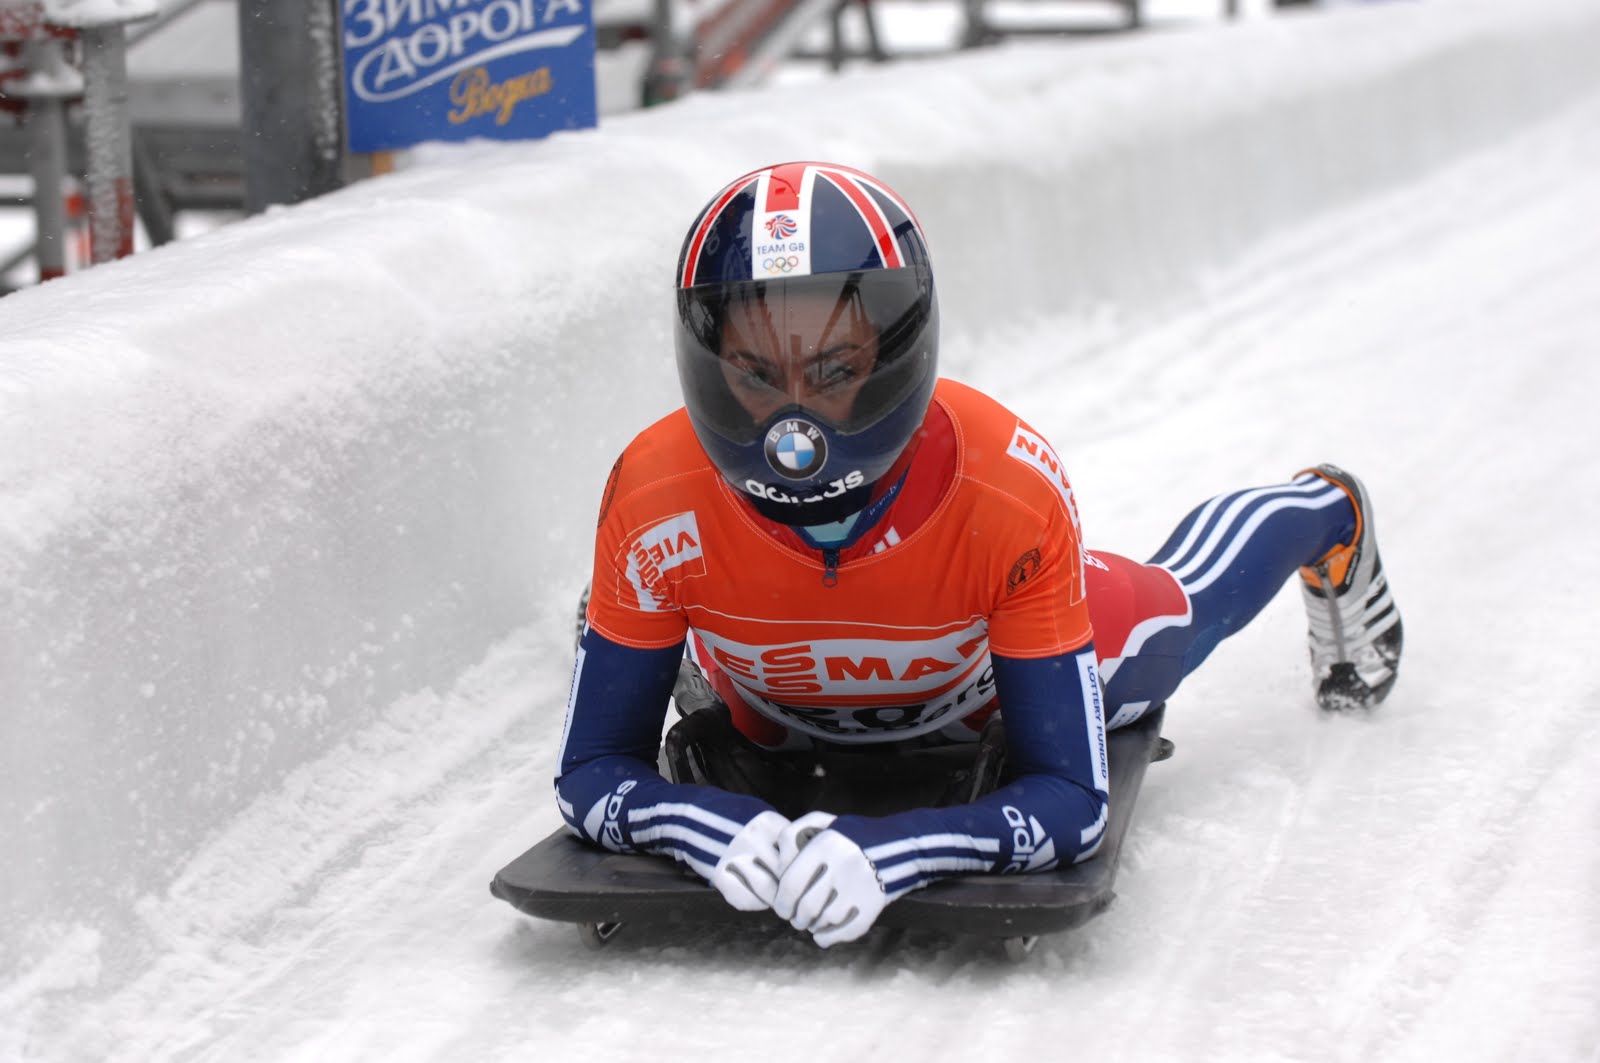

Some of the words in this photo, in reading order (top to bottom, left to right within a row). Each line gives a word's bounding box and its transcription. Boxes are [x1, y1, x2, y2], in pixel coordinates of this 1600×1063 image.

[756, 243, 786, 255] TEAM
[788, 242, 806, 252] GB
[768, 421, 820, 443] BMW
[1087, 665, 1102, 722] LOTTERY
[1096, 725, 1107, 779] FUNDED
